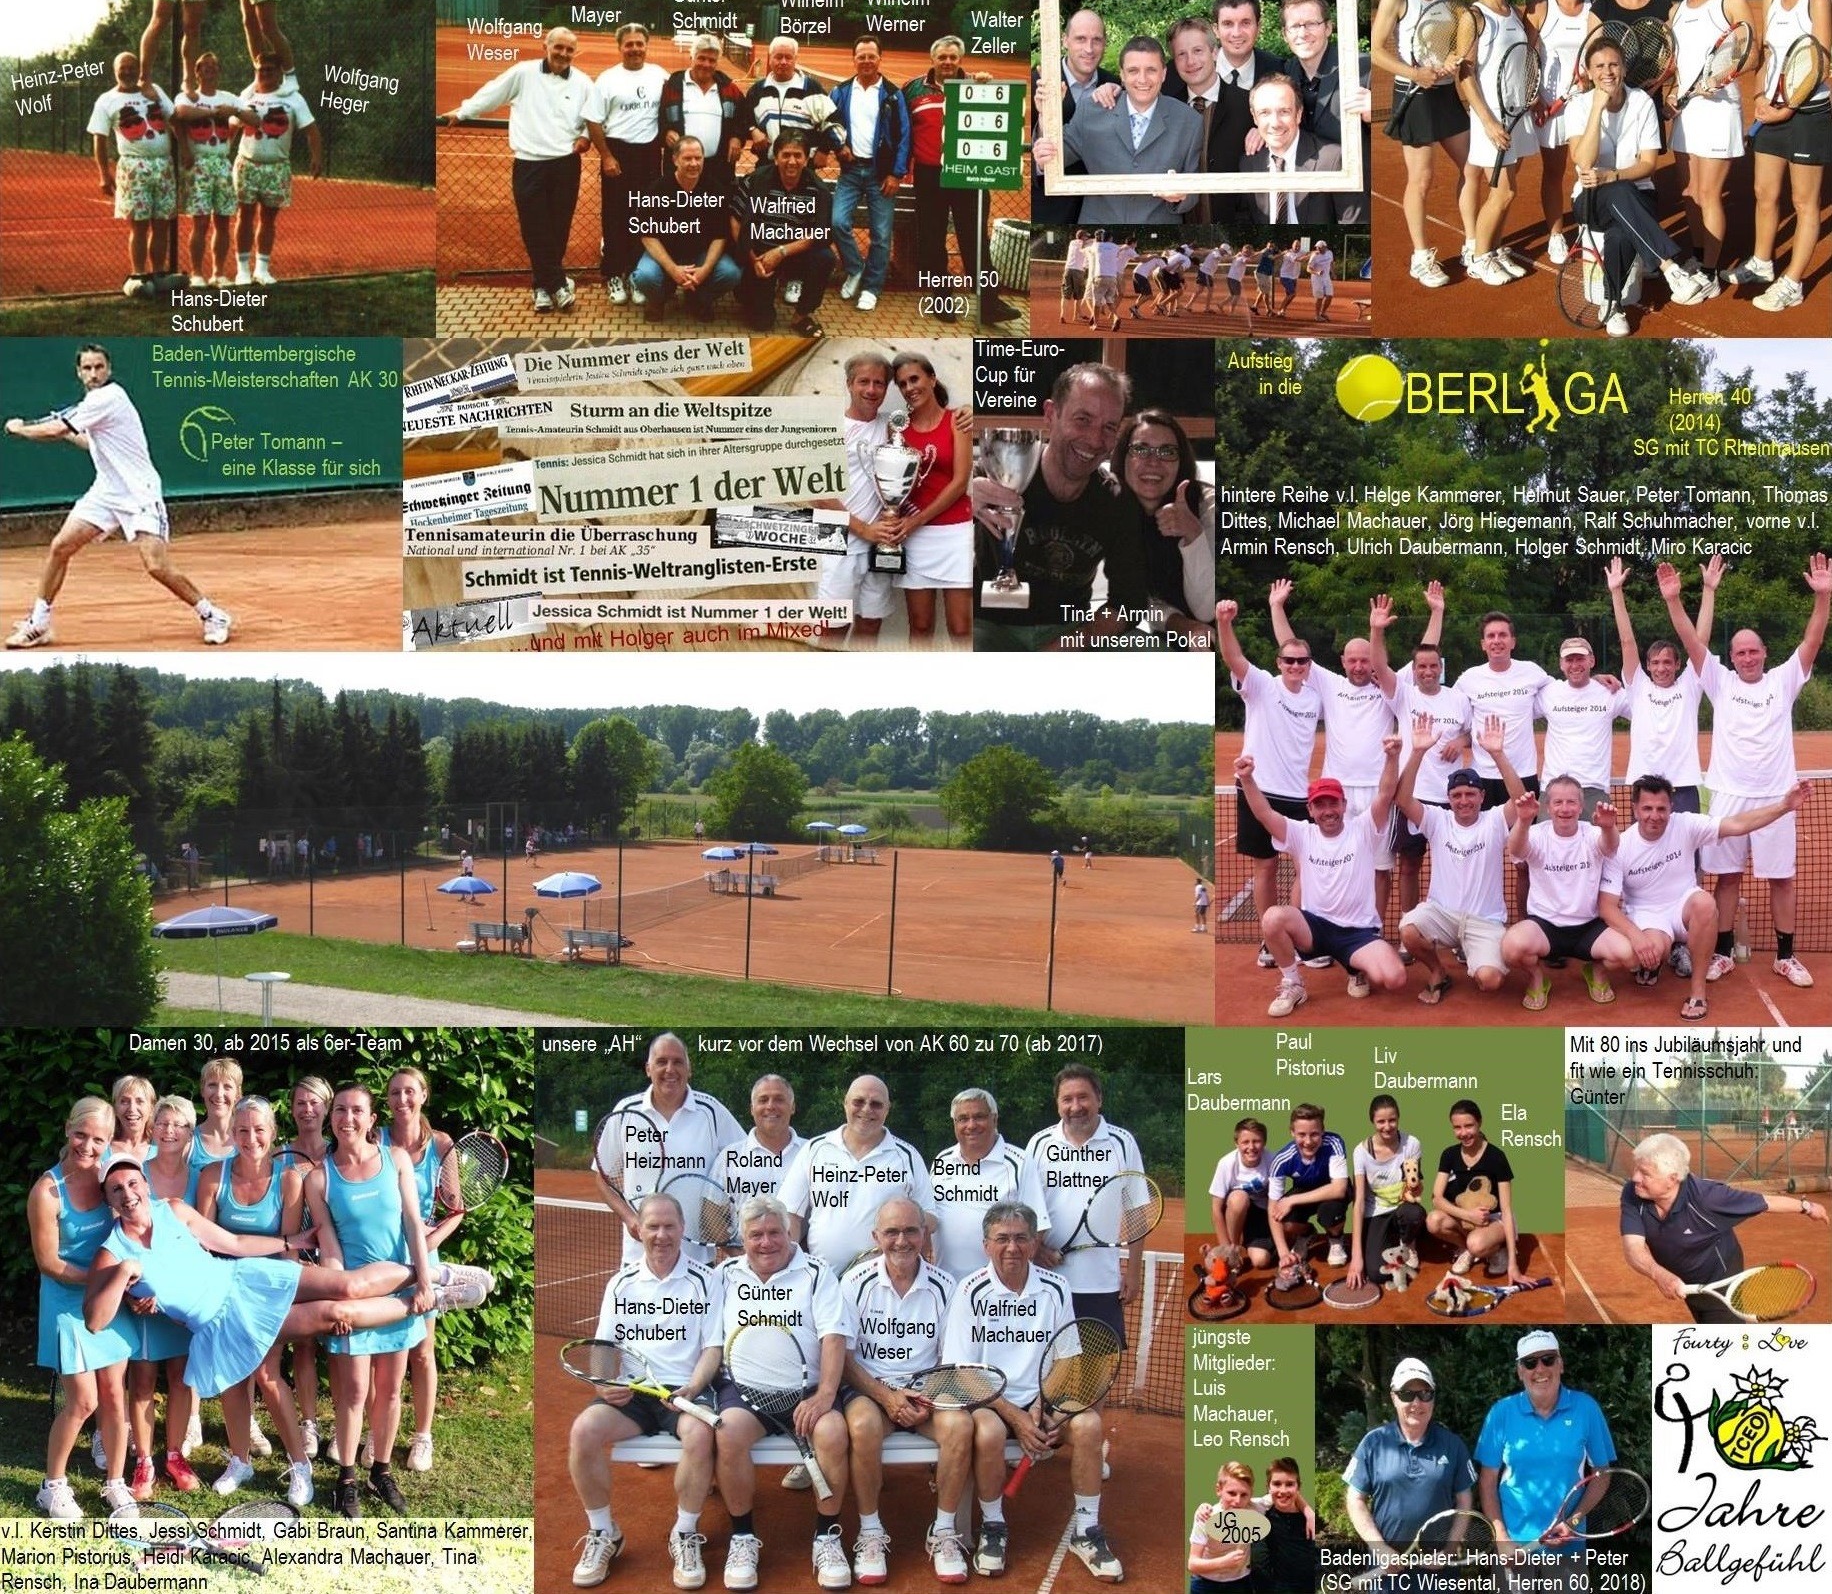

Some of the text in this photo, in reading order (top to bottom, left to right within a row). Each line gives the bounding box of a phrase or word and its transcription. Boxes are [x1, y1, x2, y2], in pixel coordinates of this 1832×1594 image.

[965, 86, 1004, 100] 0 6
[964, 114, 1003, 129] 0 6
[963, 142, 1001, 157] 0 6
[945, 164, 1018, 176] HEIM GAST
[524, 341, 745, 373] Die Nummer eins der Welt
[459, 401, 553, 425] NACHRICHTEN
[570, 403, 773, 423] Sturm an die Weltspitze
[535, 437, 846, 469] Tennis: Jessica Schmidt hat sich in ihrer Altersgruppe durchgesetzt
[538, 462, 846, 515] Nummer 1 der Welt
[405, 524, 698, 546] Tennisamateurin die Überraschung
[754, 530, 807, 545] WOCHE
[464, 555, 818, 588] Schmidt ist Tennis-Weltranglisten-Erste
[411, 603, 513, 645] Aktuell
[1552, 705, 1607, 714] Aufsteiger 2014
